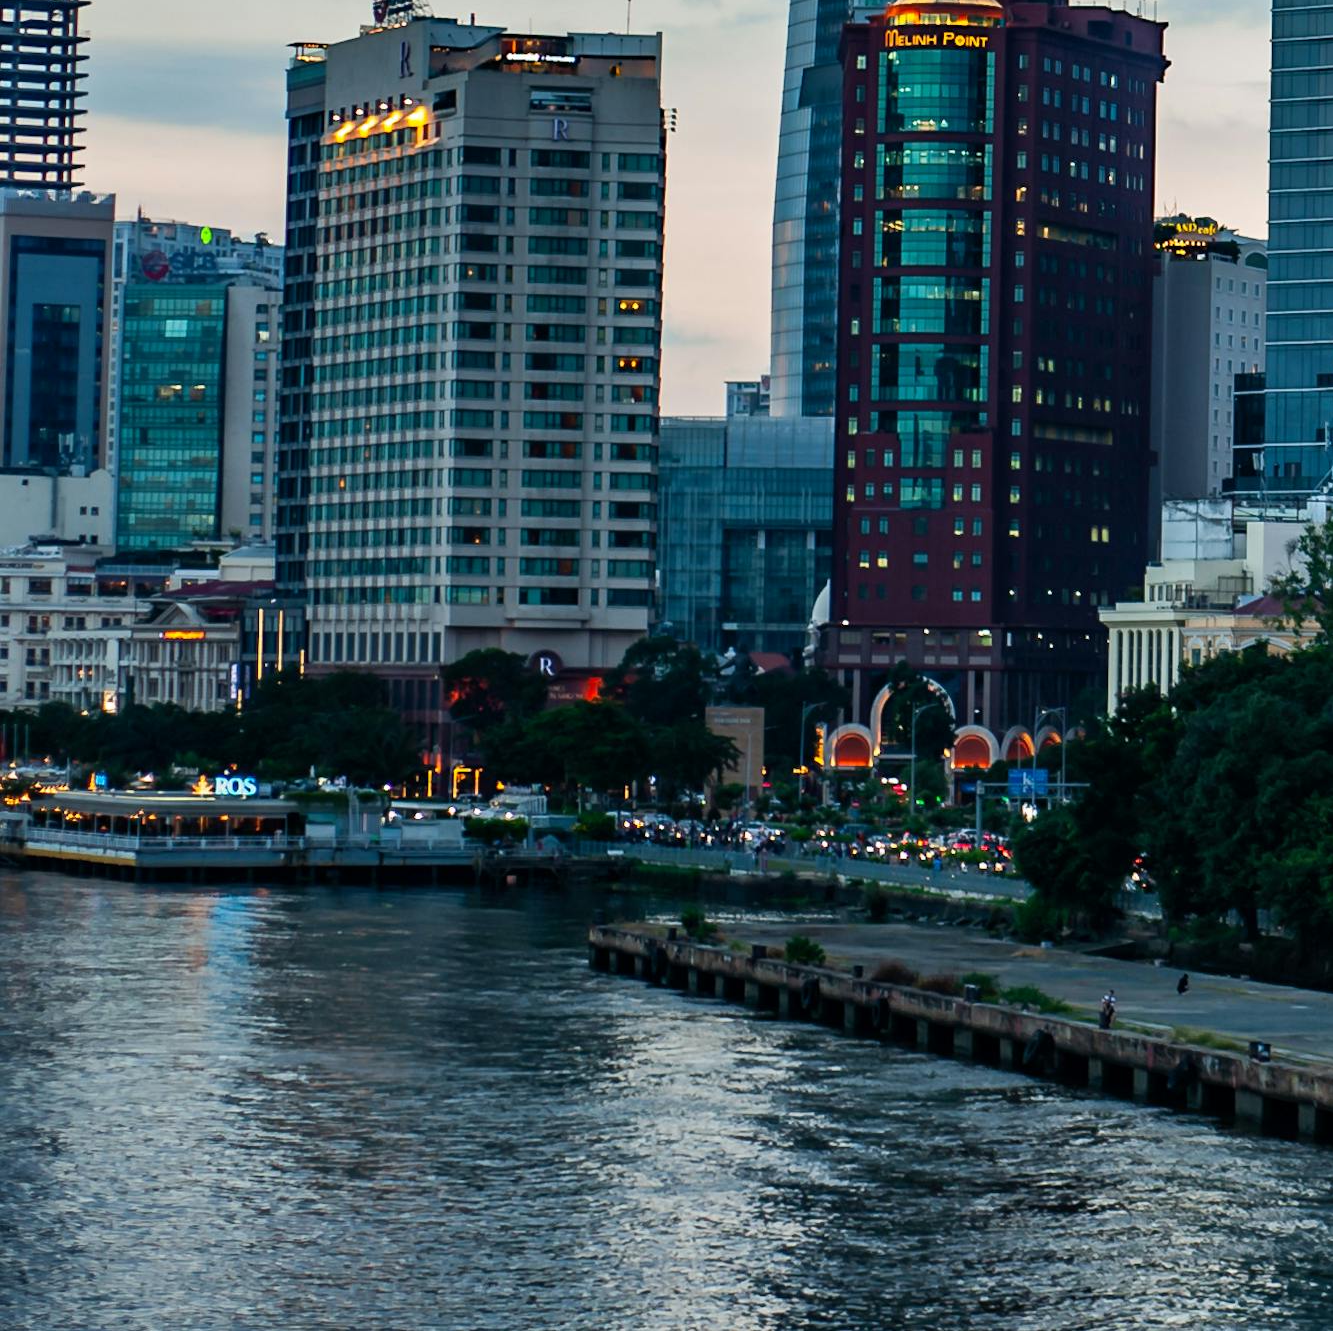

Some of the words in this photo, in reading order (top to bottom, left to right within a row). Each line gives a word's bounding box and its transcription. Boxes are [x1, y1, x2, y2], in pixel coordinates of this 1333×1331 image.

[885, 29, 937, 47] MELINH
[943, 31, 988, 48] POINT
[553, 118, 569, 141] R
[540, 656, 555, 675] R
[215, 776, 257, 795] ROS
